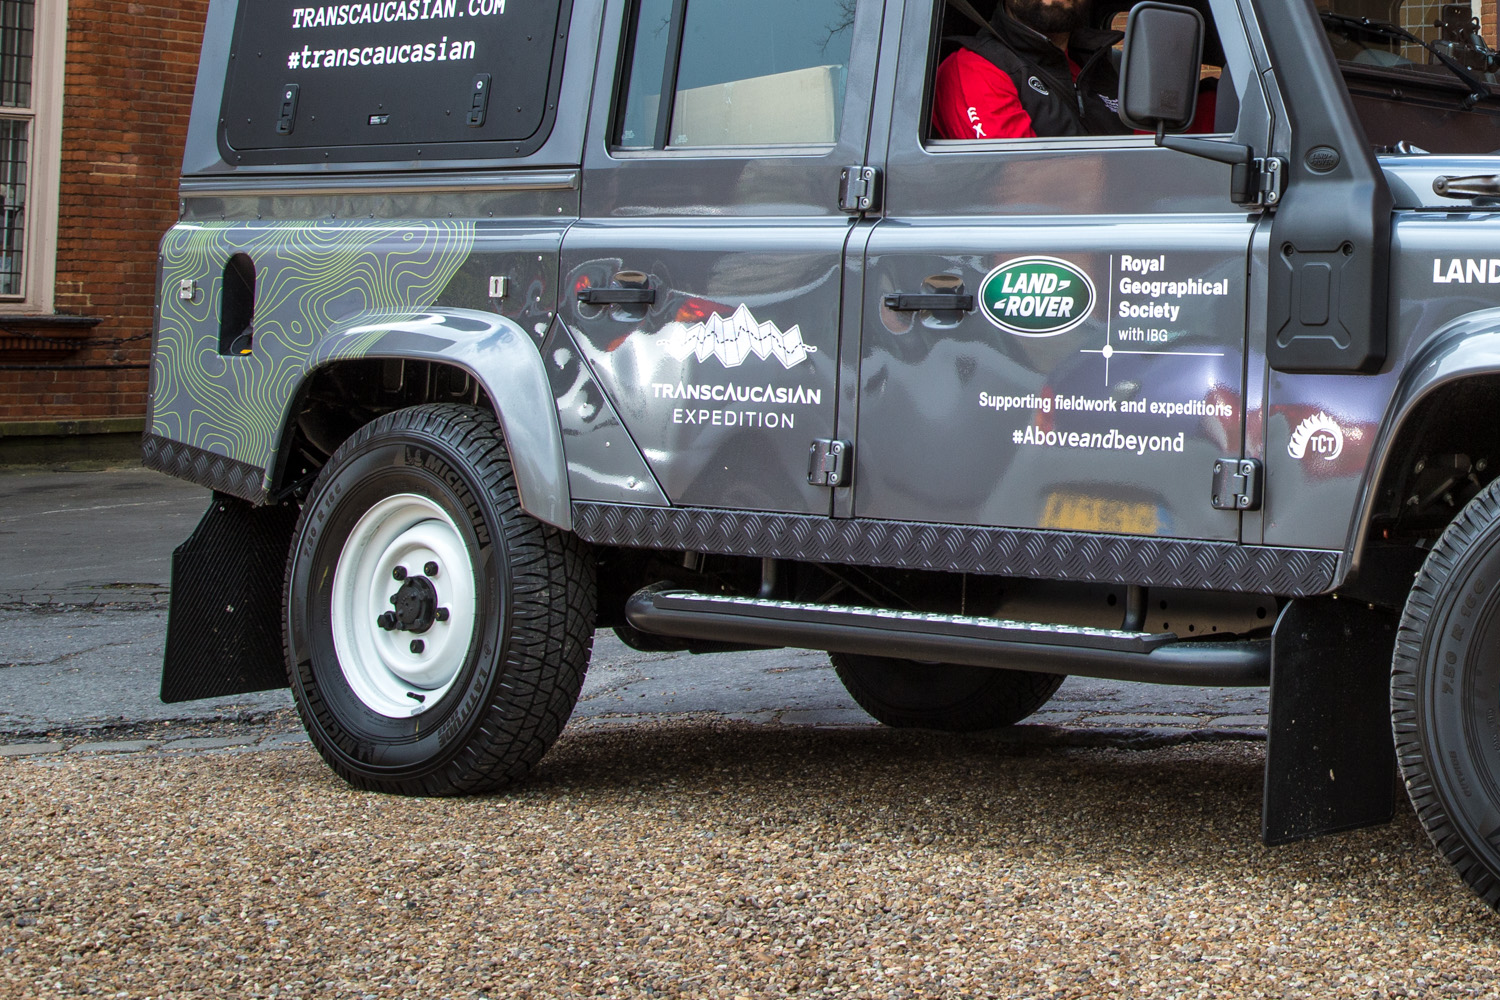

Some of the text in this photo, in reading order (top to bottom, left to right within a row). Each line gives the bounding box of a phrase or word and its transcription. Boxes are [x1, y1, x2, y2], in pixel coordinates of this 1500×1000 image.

[287, 36, 476, 70] #transcaucasian
[1121, 255, 1165, 275] Royal
[1002, 272, 1059, 294] LAND
[1119, 278, 1229, 298] Geographical
[1003, 296, 1074, 318] ROVER
[1118, 301, 1180, 323] Society
[1118, 327, 1168, 342] with IBG
[651, 380, 821, 405] TRANSCAUCASIAN
[978, 391, 1233, 418] Supporting fieldwork and expeditions
[672, 408, 795, 429] EXPEDITION
[1012, 425, 1185, 456] #Aboveandbeyond
[425, 453, 491, 544] MICHELIN
[298, 666, 357, 755] MICHELIN
